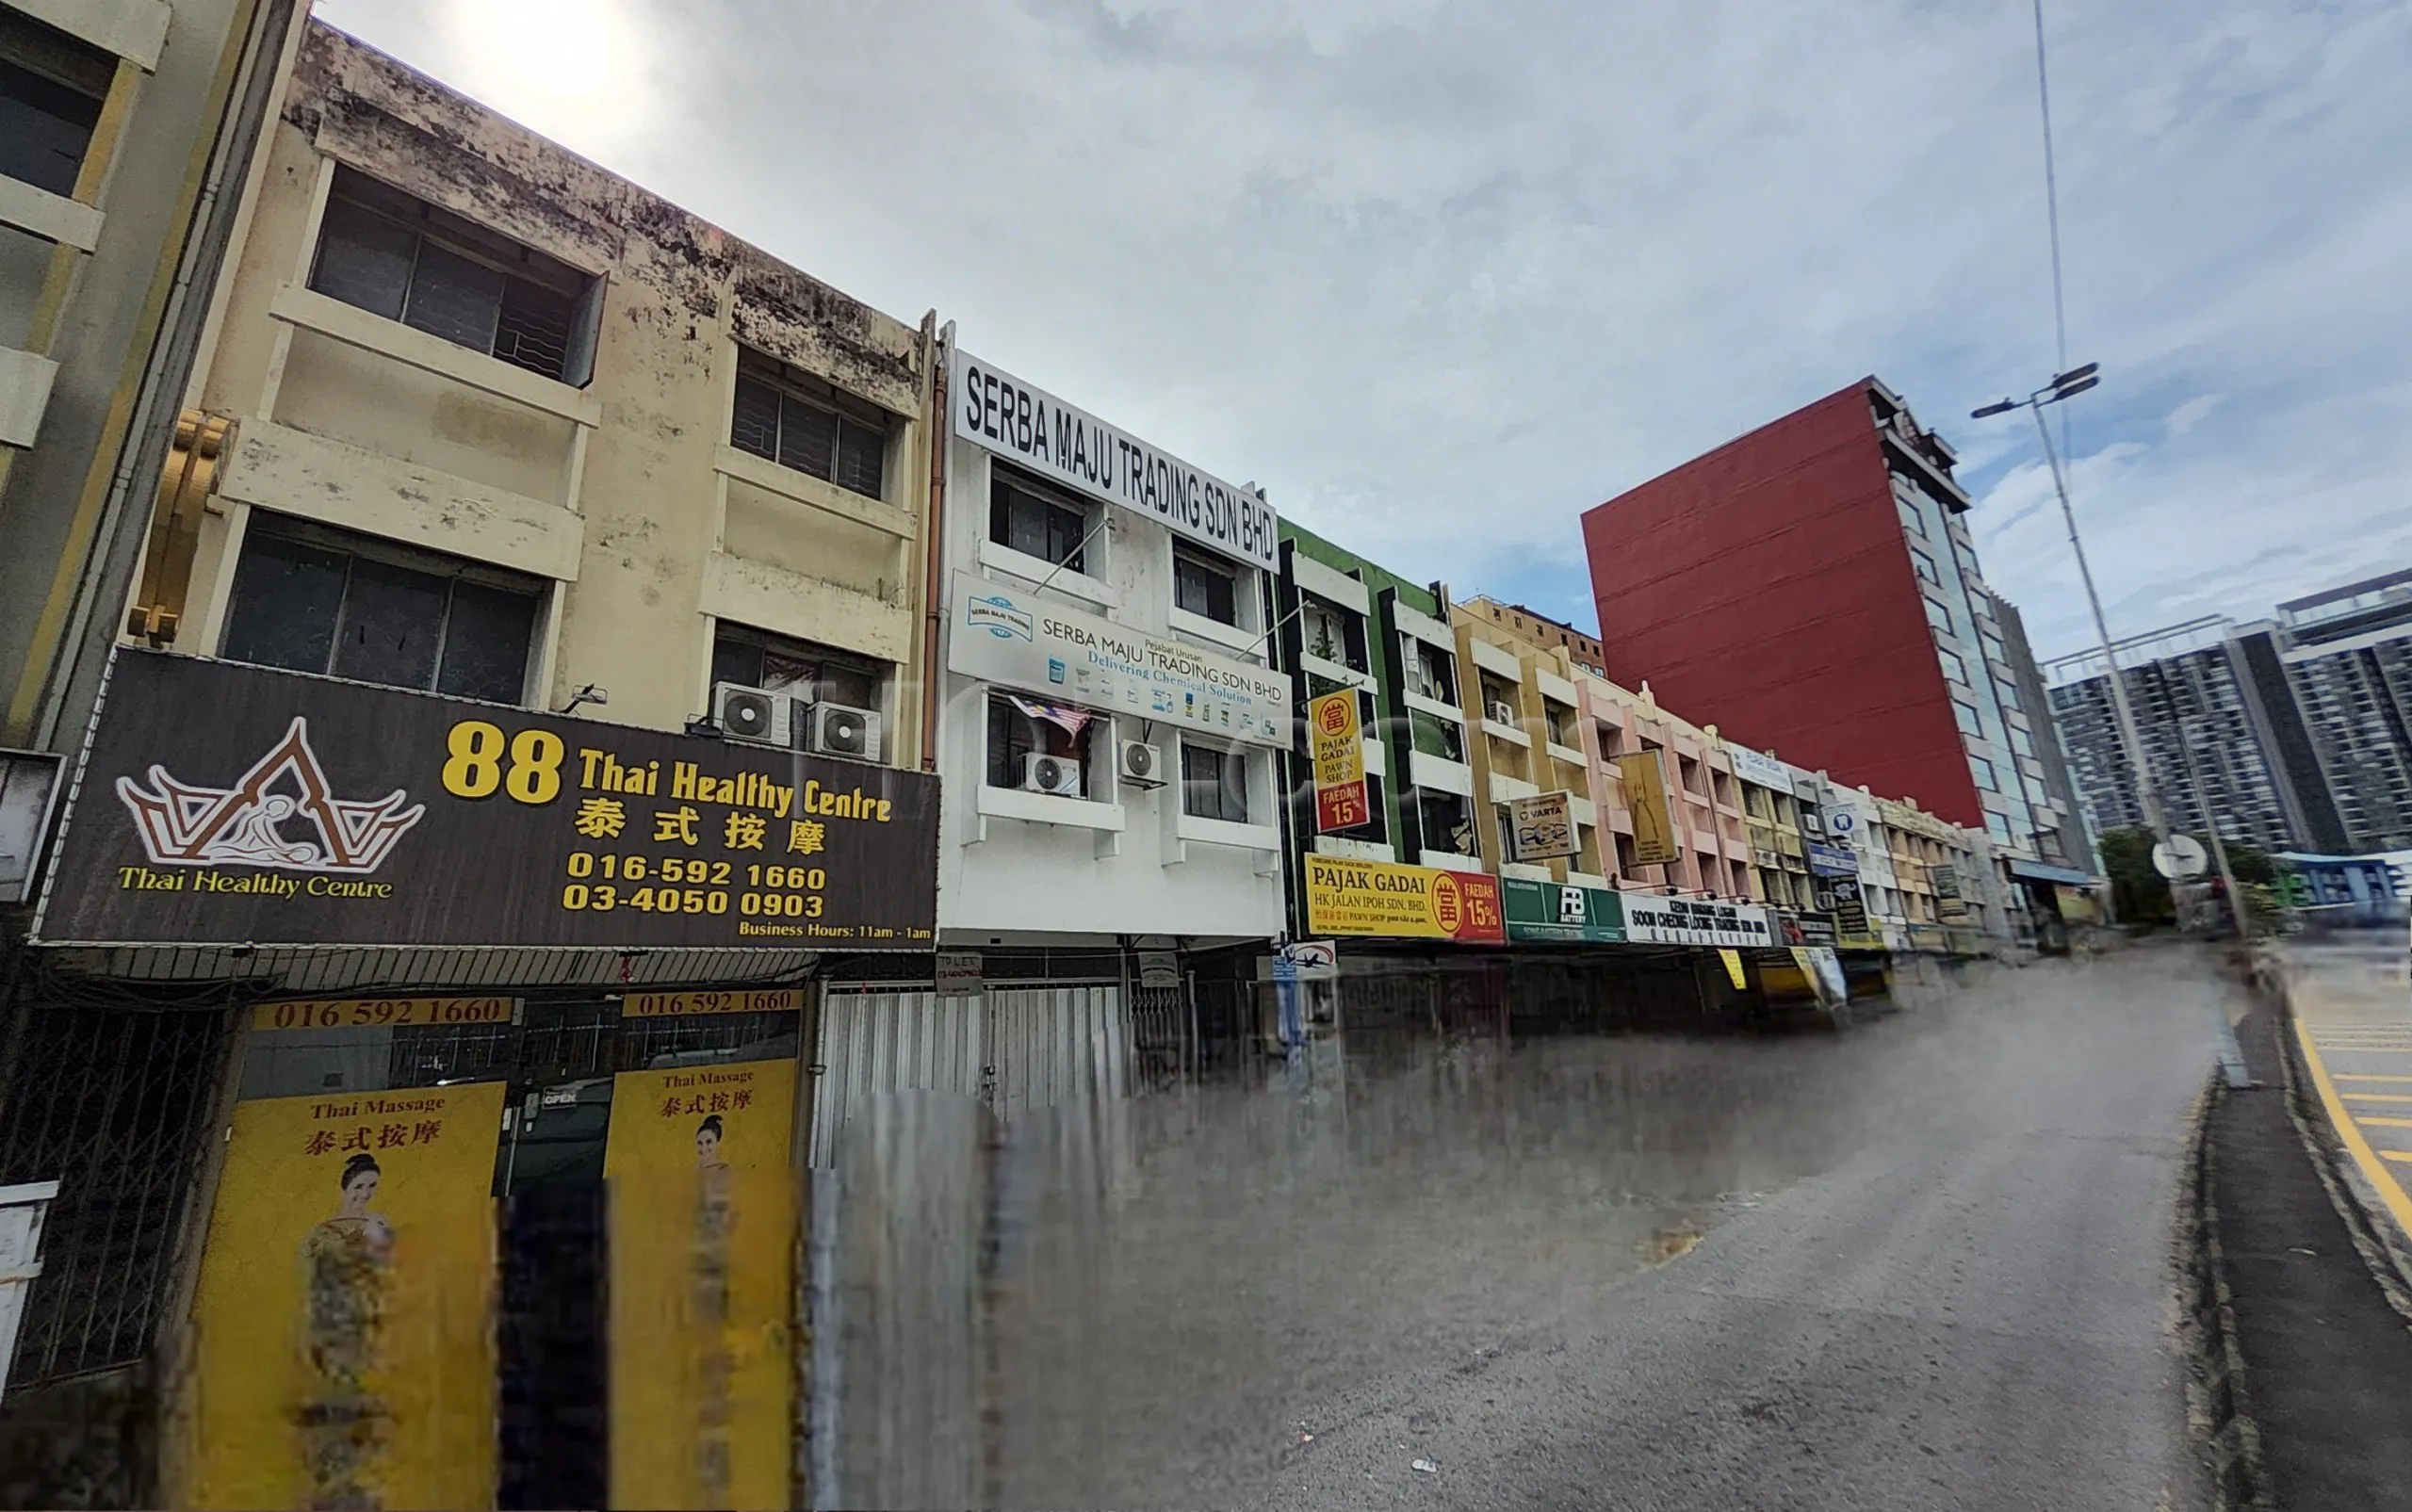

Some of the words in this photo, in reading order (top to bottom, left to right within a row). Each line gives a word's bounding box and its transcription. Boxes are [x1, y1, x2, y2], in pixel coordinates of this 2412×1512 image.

[966, 365, 1050, 463] SERBA
[1055, 407, 1113, 490] MAJU
[1118, 440, 1200, 528] TRADING
[1204, 481, 1238, 547] SDN
[1242, 501, 1274, 562] BHD
[1043, 618, 1097, 649] SERBA
[1101, 637, 1143, 662] MAJU
[1148, 650, 1218, 683] TRADING
[1222, 672, 1251, 692] SDN
[1254, 682, 1281, 701] BHD
[1176, 648, 1202, 662] Urusan
[1088, 650, 1149, 680] Delivering
[1153, 671, 1206, 692] Chemical
[1210, 685, 1252, 706] Solution
[1321, 736, 1352, 752] PAJAK
[1321, 746, 1355, 762] GADAI
[442, 720, 565, 805] 88
[578, 748, 660, 797] Thai
[672, 760, 795, 818] Healthy
[804, 780, 892, 823] Centre
[1325, 759, 1353, 774] PAWN
[1327, 771, 1352, 783] SHOP
[1323, 786, 1360, 805] FAEDAH
[1530, 806, 1562, 818] VARTA
[574, 798, 825, 855] 泰式按摩
[118, 866, 186, 891] Thai
[193, 870, 301, 899] Healthy
[306, 875, 392, 899] Centre
[566, 853, 731, 886] 016-592
[746, 864, 826, 891] 1660
[1312, 866, 1371, 893] PAJAK
[1375, 872, 1426, 894] GADAI
[1464, 882, 1494, 898] FAEDAH
[562, 885, 728, 916] 03-4050
[740, 893, 824, 919] 0903
[1314, 893, 1329, 905] HK
[1331, 894, 1361, 909] JALAN
[1362, 895, 1384, 909] IPOH
[1386, 898, 1407, 911] SDN.
[1408, 900, 1427, 912] BHD.
[1349, 912, 1368, 921] PAWN
[1369, 913, 1385, 922] SHOP
[1560, 914, 1587, 923] BATTERY
[739, 920, 804, 937] Business
[807, 922, 854, 938] Hours:
[858, 925, 893, 938] 11am
[906, 926, 932, 939] 1am
[274, 1002, 340, 1028] 016
[351, 1000, 414, 1026] 592
[429, 999, 501, 1023] 1660
[639, 994, 683, 1015] 016
[691, 993, 732, 1012] 592
[742, 991, 792, 1011] 1660
[663, 1075, 695, 1088] Thai
[697, 1070, 754, 1086] Massage
[311, 1099, 359, 1120] Thai
[364, 1097, 446, 1116] Massage
[546, 1094, 576, 1104] OPEN
[660, 1089, 753, 1117] 泰式按摩
[304, 1119, 443, 1157] 泰式按摩
